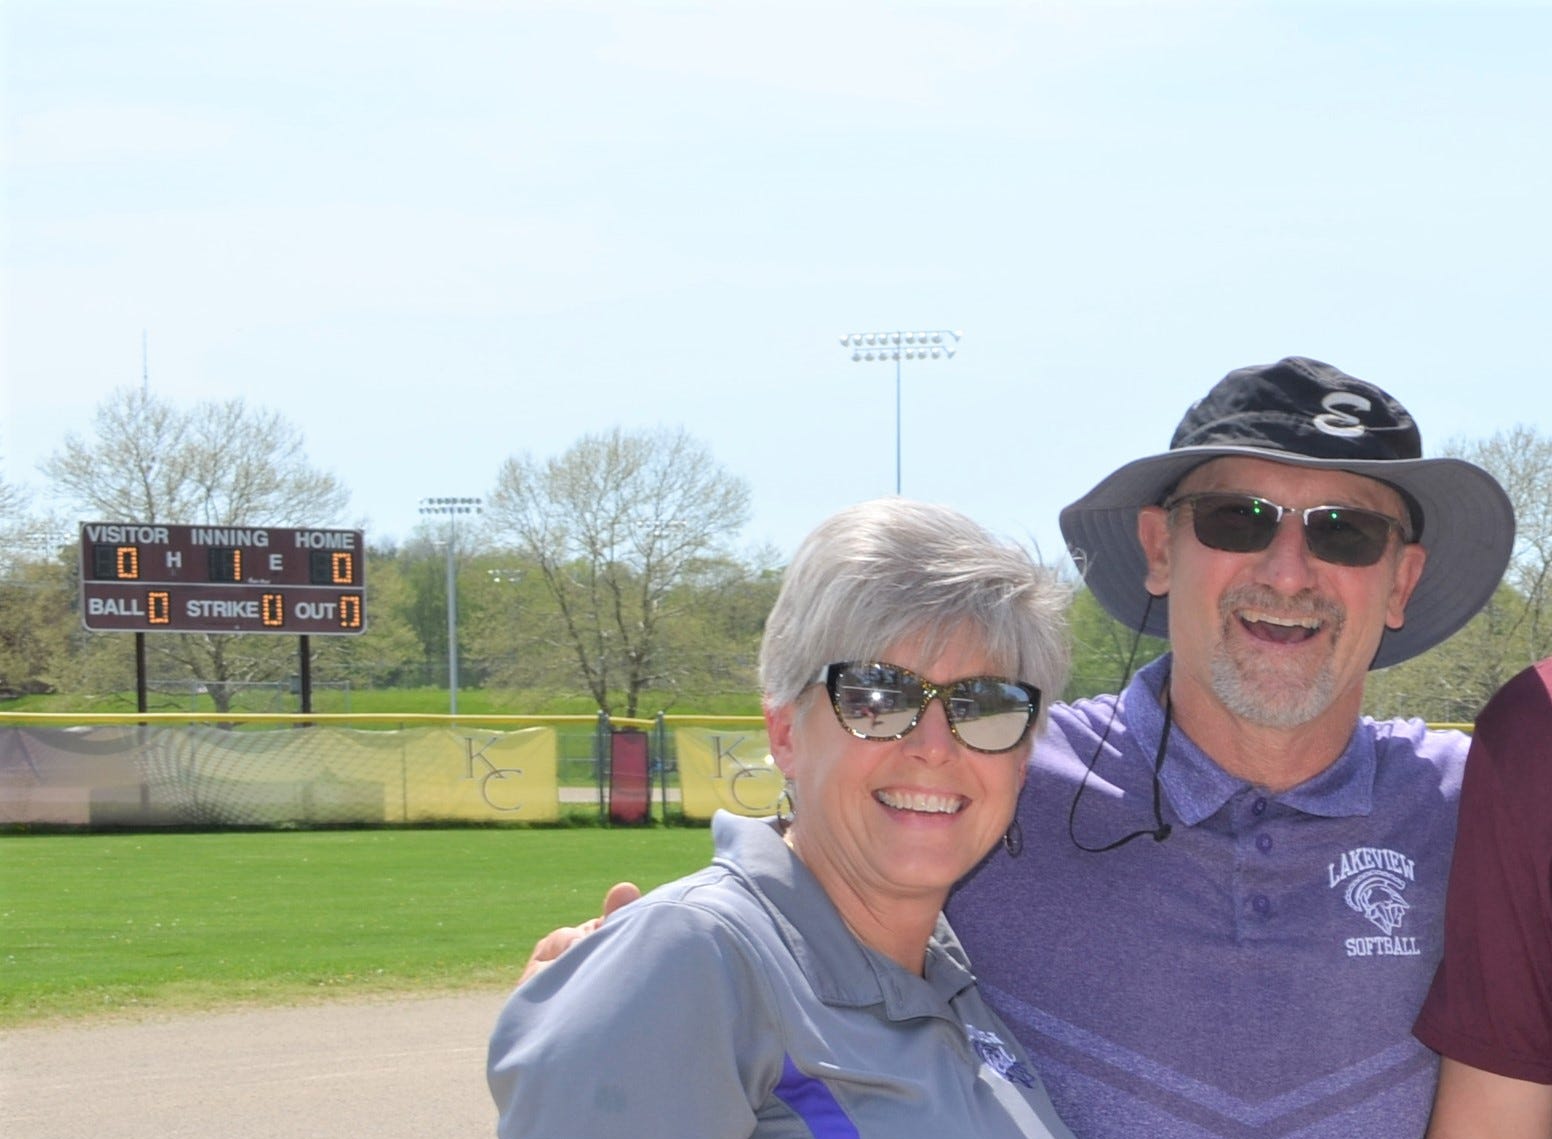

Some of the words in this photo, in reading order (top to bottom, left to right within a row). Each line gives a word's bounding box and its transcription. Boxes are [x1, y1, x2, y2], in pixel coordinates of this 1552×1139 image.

[86, 526, 168, 544] VISITOR
[191, 528, 269, 546] INNING
[295, 531, 354, 549] HOME
[117, 547, 138, 579] 0
[166, 552, 182, 568] H
[233, 550, 241, 581] 1
[269, 554, 283, 571] E
[332, 552, 352, 583] 0
[89, 598, 145, 616] BALL
[148, 592, 169, 623] 0
[186, 600, 260, 618] STRIKE
[295, 602, 336, 620] OUT
[1328, 847, 1415, 888] LAKEVIEW
[1345, 936, 1421, 956] SOFTBALL
